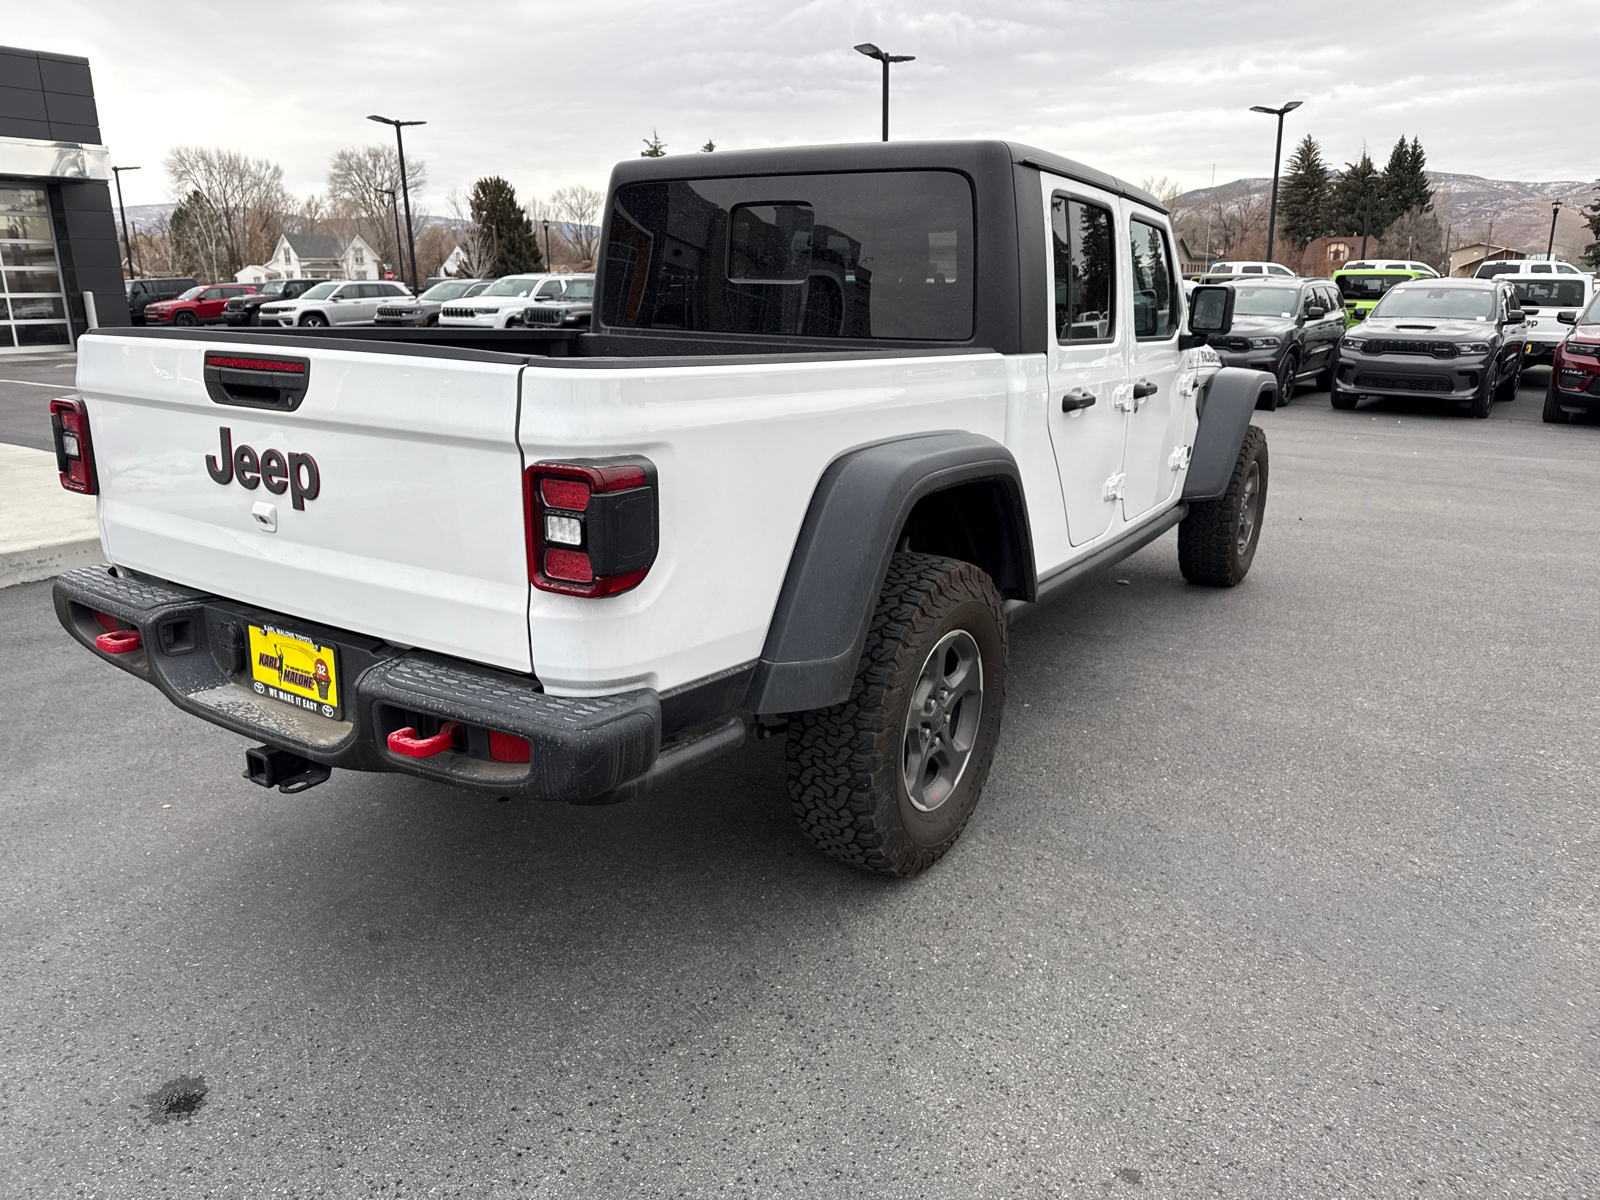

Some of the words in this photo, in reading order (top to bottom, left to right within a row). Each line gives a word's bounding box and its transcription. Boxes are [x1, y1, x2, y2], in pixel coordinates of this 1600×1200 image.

[205, 426, 321, 511] Jeep
[295, 634, 313, 644] TOYOTA
[259, 653, 278, 670] KARL
[317, 664, 326, 676] 32
[284, 668, 315, 690] MALONE
[269, 687, 278, 698] WE
[279, 691, 294, 704] MAKE
[296, 698, 301, 706] IT
[303, 701, 317, 711] EASY
